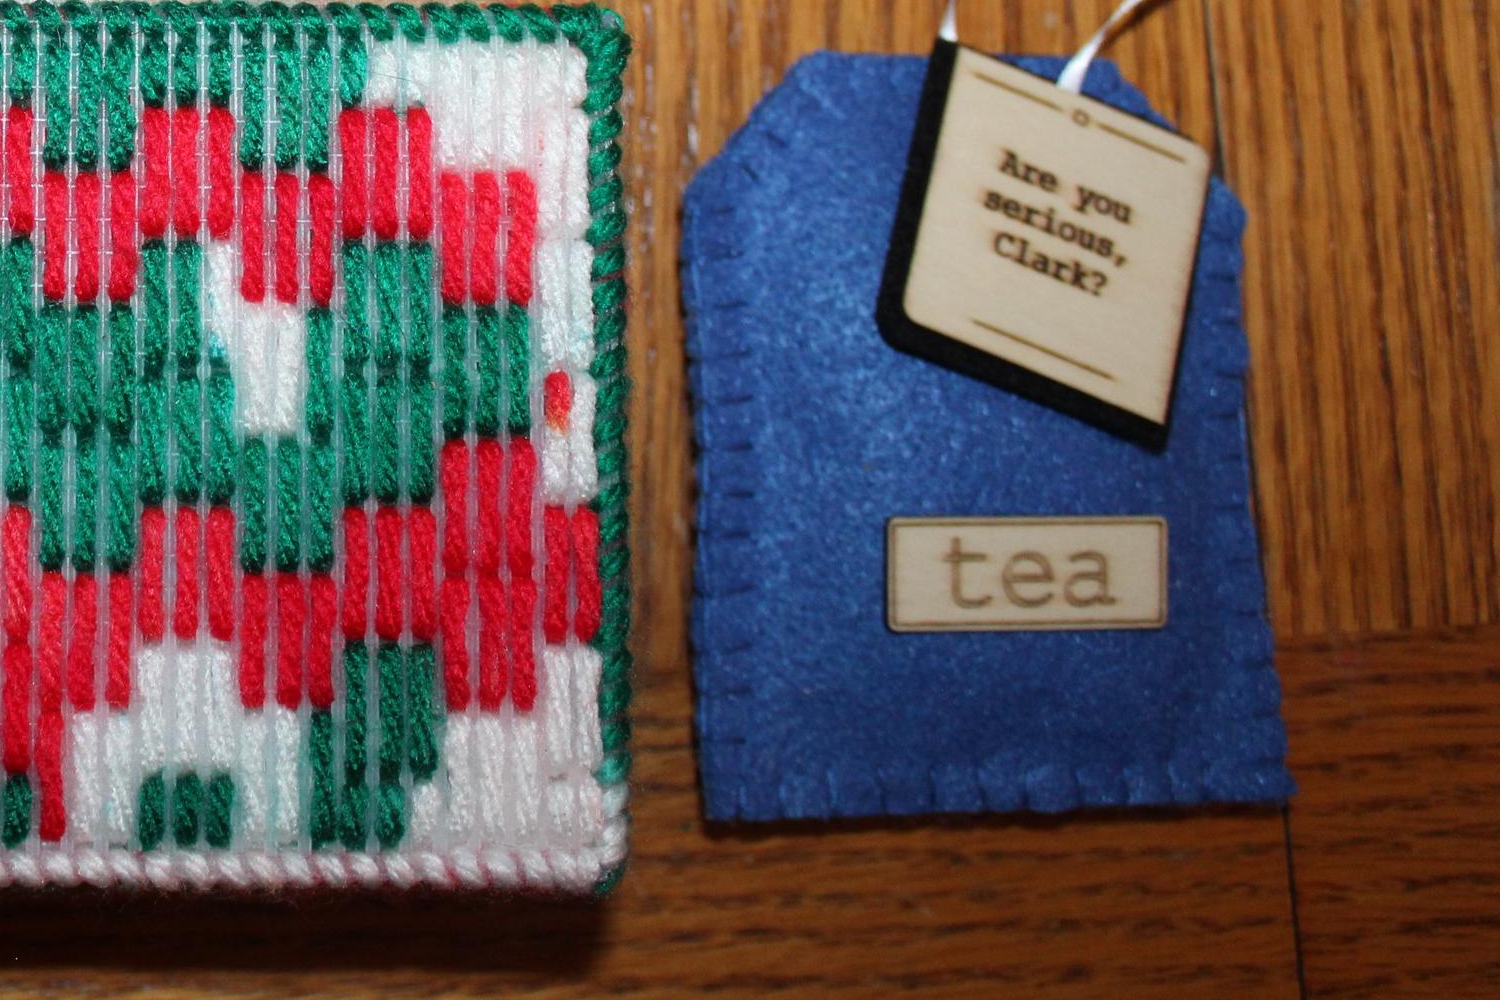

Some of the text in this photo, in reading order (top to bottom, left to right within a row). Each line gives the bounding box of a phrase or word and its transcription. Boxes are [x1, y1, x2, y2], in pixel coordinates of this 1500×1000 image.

[999, 148, 1131, 224] Are you
[984, 190, 1127, 268] serious,
[994, 233, 1108, 297] Clark?
[944, 536, 1117, 609] tea
